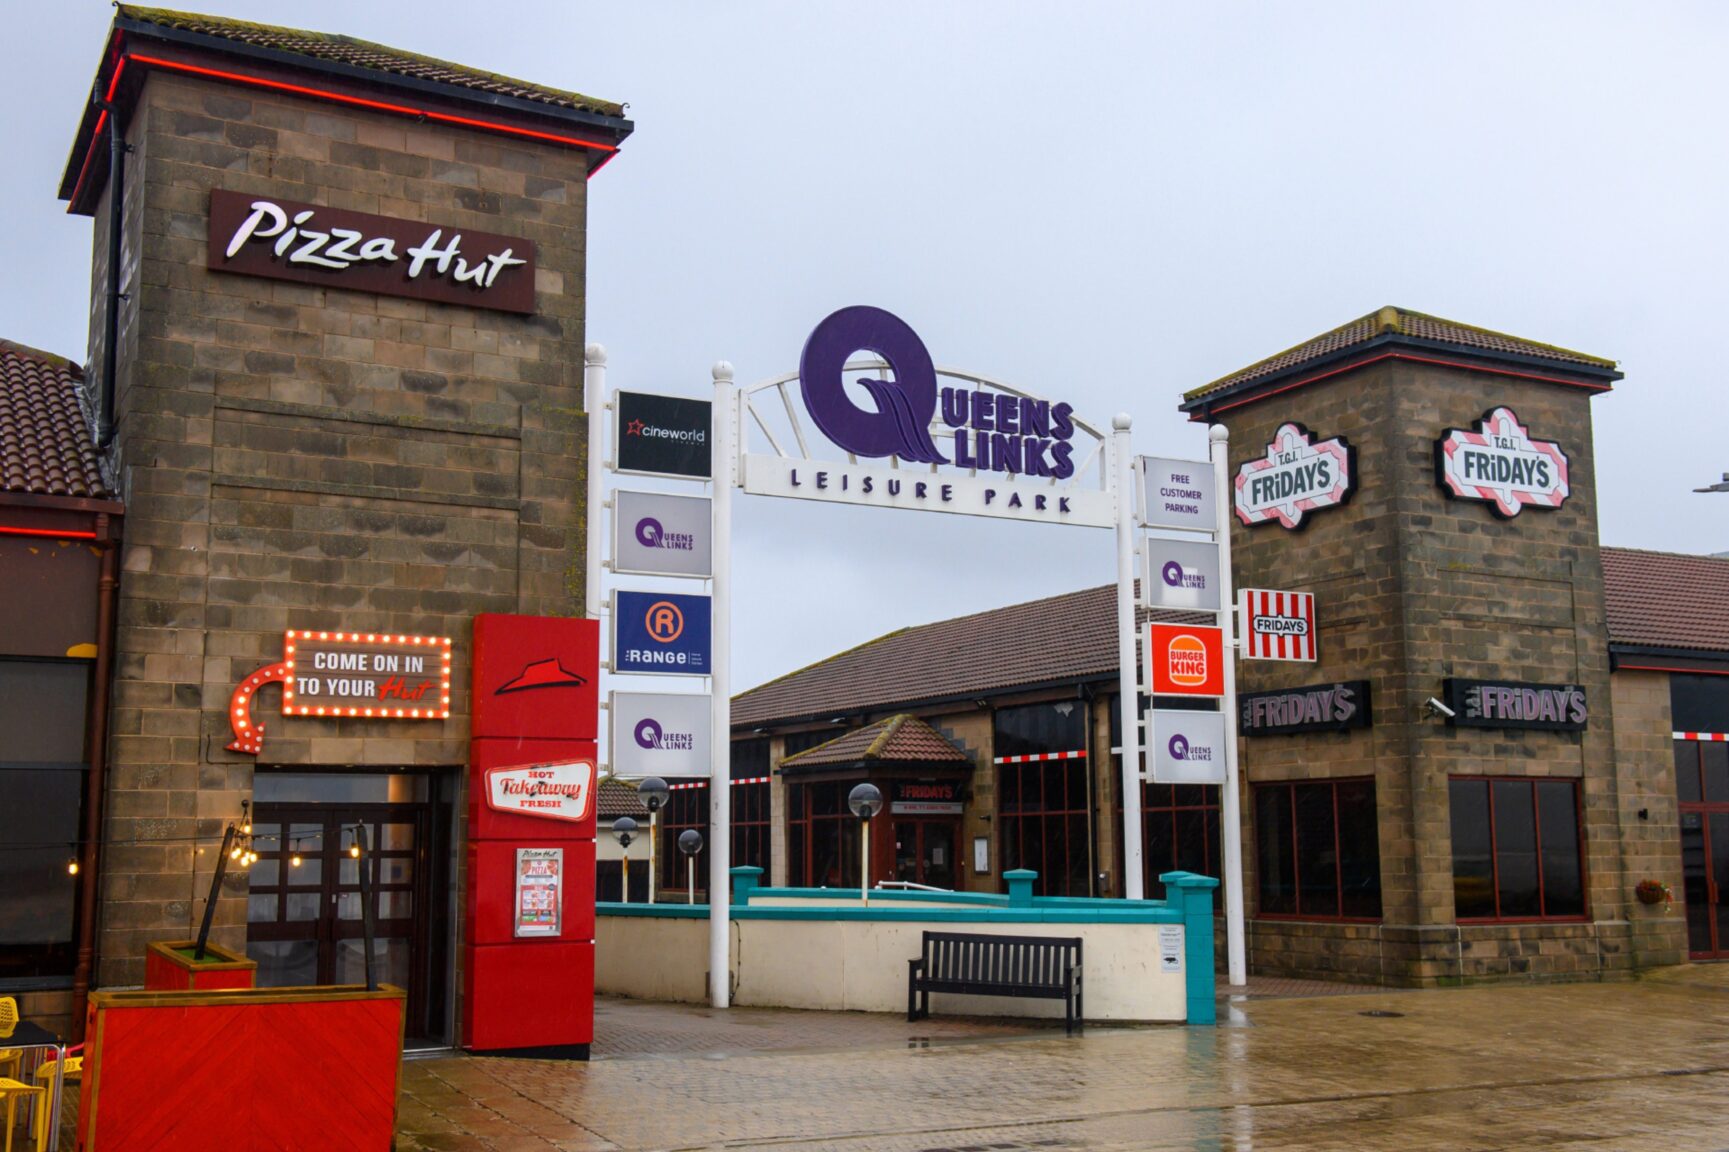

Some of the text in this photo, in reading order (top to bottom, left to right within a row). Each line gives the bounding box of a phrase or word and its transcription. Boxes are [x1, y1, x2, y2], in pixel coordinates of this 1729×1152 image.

[226, 201, 527, 288] Pizza Hut
[642, 425, 705, 442] cineworld
[1494, 437, 1516, 451] T.G.I.
[955, 429, 1074, 479] LINKS
[1278, 451, 1298, 466] T.G.I.
[1171, 474, 1190, 484] FREE
[791, 468, 1071, 513] LEISURE PARK
[1160, 487, 1202, 500] CUSTOMER
[1165, 503, 1199, 514] PARKING
[667, 541, 693, 551] LINKS
[1186, 581, 1206, 589] LINKS
[1257, 619, 1304, 632] FRIDAYS
[314, 652, 423, 673] COME ON IN
[1170, 651, 1204, 661] BURGER
[1171, 660, 1205, 675] KING
[297, 674, 436, 702] TO YOUR Hut
[666, 742, 693, 750] LINKS
[500, 777, 581, 800] Takeaway
[520, 800, 562, 808] FRESH
